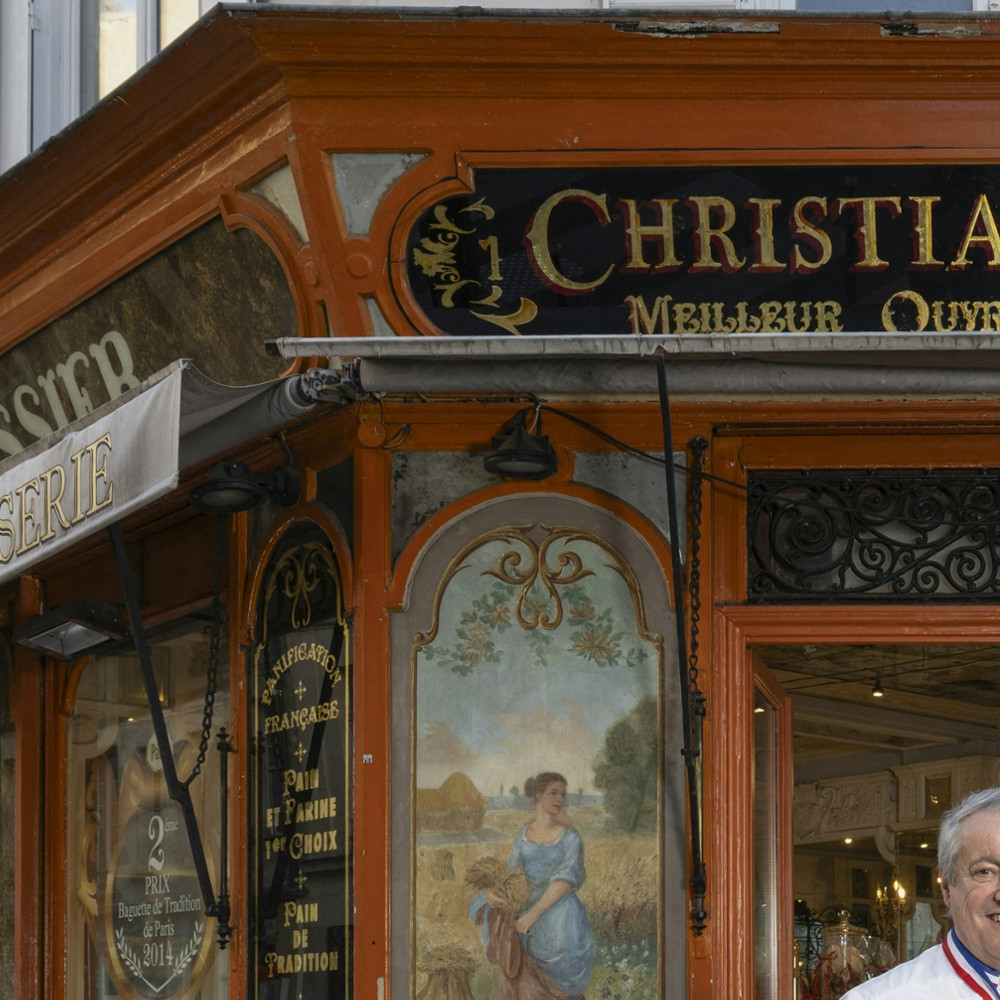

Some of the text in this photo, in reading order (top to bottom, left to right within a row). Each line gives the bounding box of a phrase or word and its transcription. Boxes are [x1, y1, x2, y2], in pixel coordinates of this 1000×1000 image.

[624, 294, 844, 334] MEILLEUR
[0, 432, 114, 564] SERIE
[261, 642, 342, 706] PANIFICATION
[264, 700, 339, 735] FRANÇAISE
[282, 768, 320, 797] PAIN
[266, 796, 337, 828] ET FARINE
[289, 830, 338, 860] CHOIX
[144, 873, 171, 895] PRIX
[118, 894, 201, 922] Baguette de Tradition
[283, 900, 319, 927] PAIN
[143, 919, 175, 938] de Paris
[292, 928, 309, 949] DE
[143, 940, 174, 967] 2014
[264, 951, 339, 979] TRADITION
